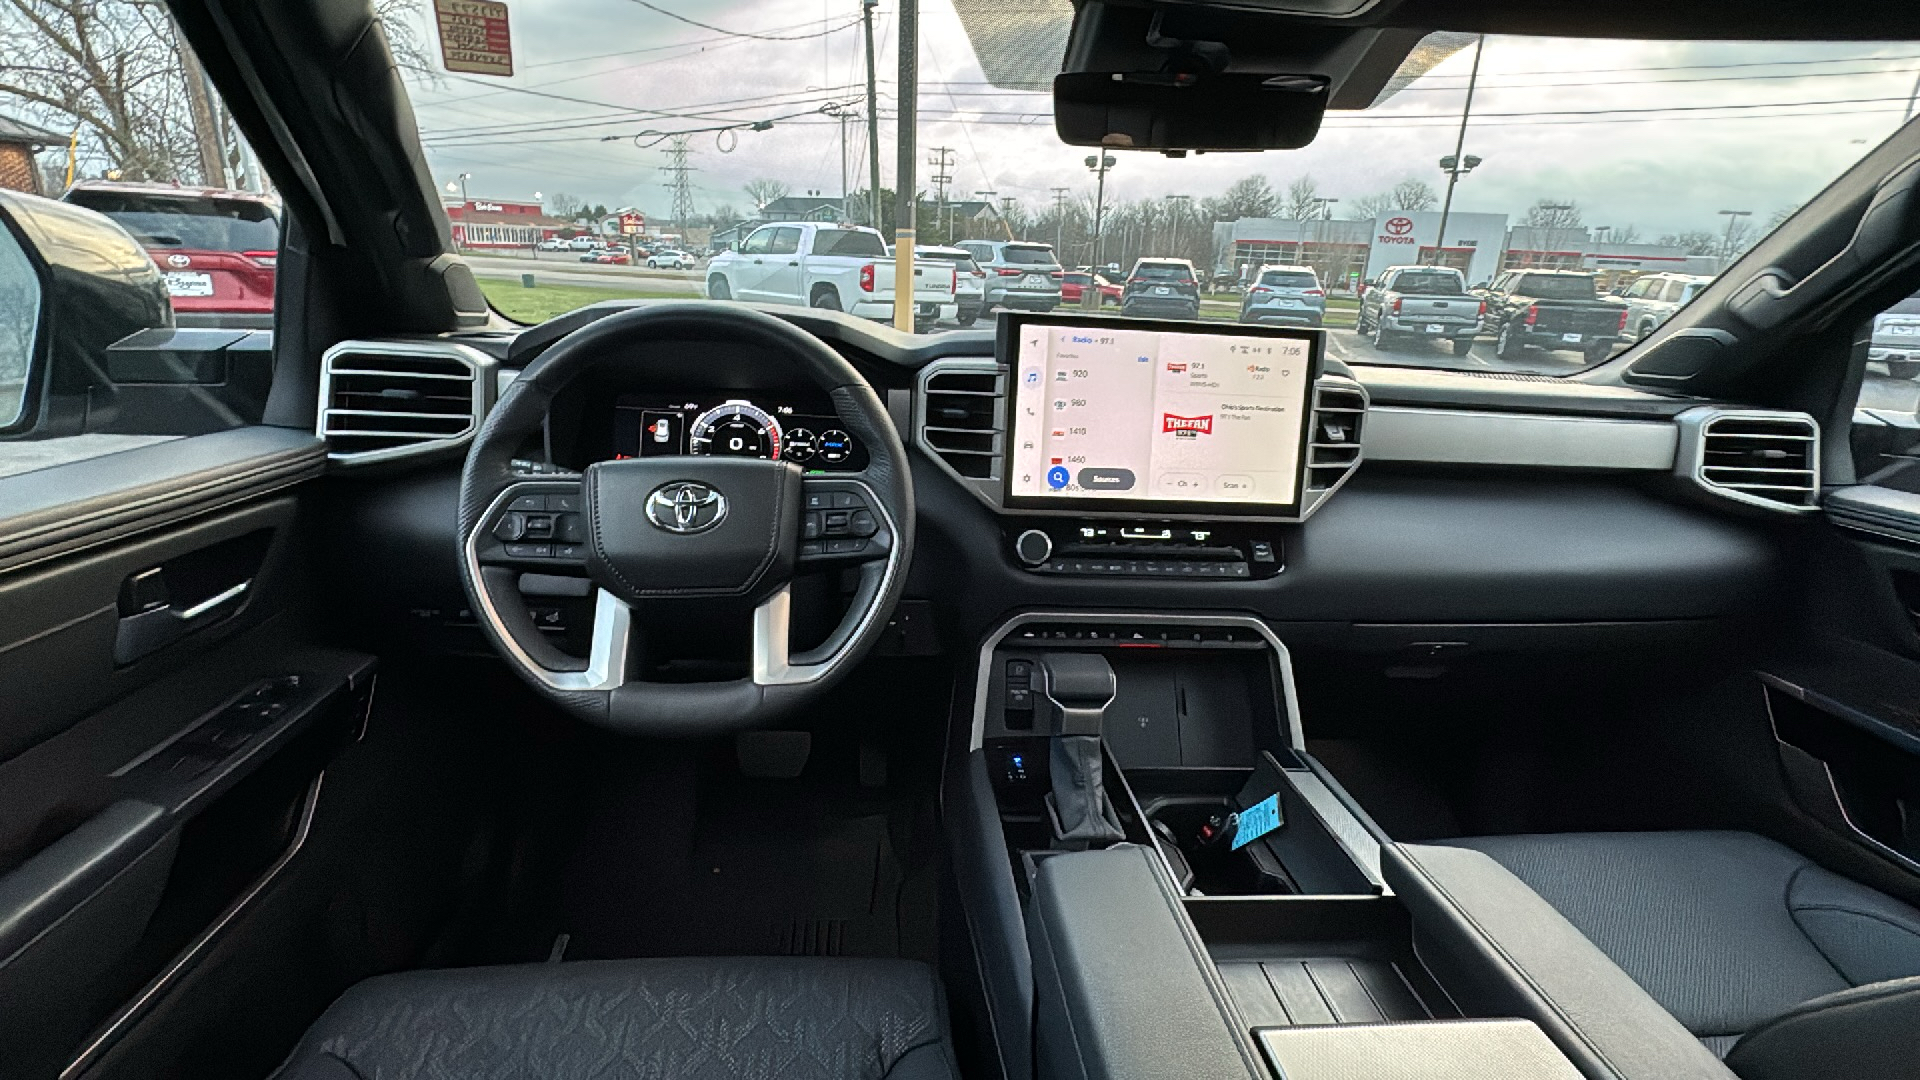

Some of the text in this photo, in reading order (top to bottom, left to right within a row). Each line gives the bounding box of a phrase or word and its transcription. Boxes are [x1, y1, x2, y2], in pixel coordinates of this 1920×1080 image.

[1378, 235, 1415, 245] TOYOTA
[1072, 336, 1093, 344] Radio
[1072, 369, 1089, 378] 920
[1069, 427, 1087, 436] 1410
[729, 437, 743, 451] 0
[1223, 482, 1239, 490] Scan
